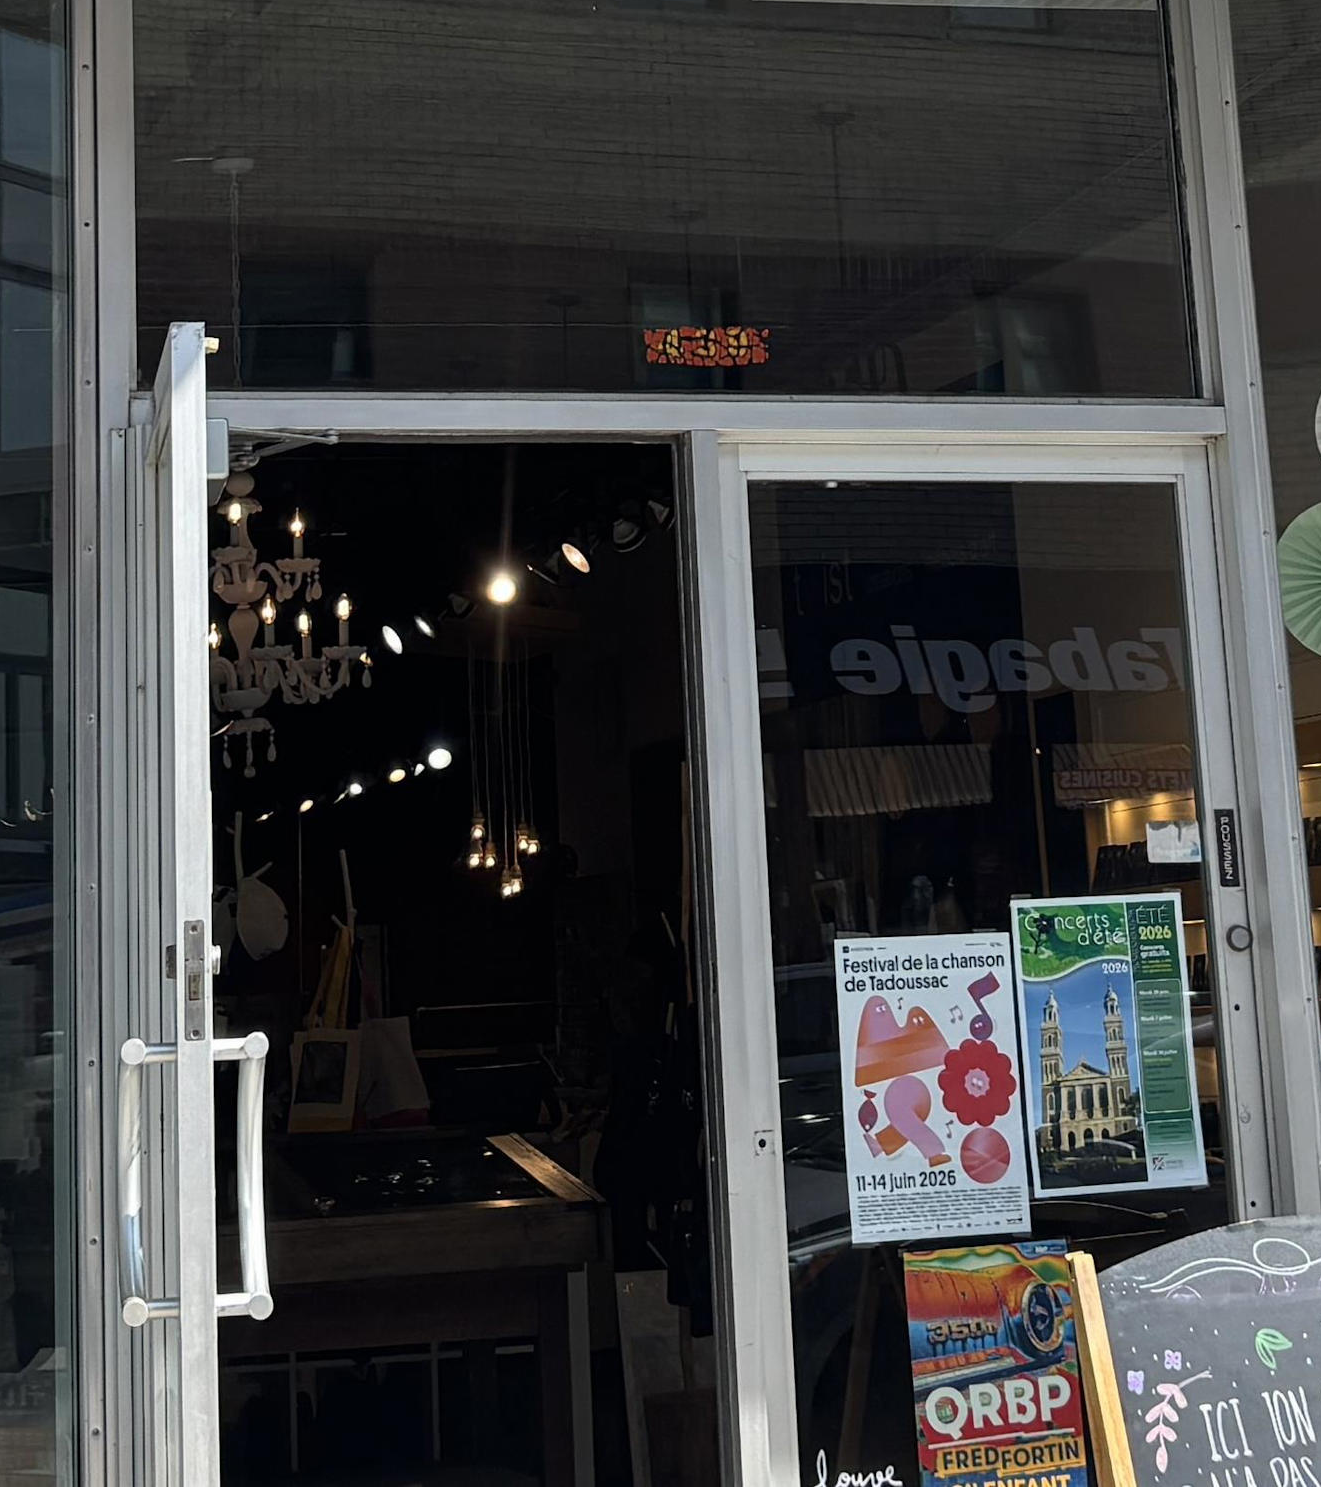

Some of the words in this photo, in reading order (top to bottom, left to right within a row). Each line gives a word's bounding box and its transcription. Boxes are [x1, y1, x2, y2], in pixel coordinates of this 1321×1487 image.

[1219, 816, 1234, 880] POUSSEZ
[1136, 905, 1170, 924] ÉTÉ
[1138, 925, 1172, 941] 2026
[843, 954, 899, 974] Festival
[901, 954, 923, 970] de
[925, 953, 939, 969] la
[941, 953, 1005, 969] chanson
[1101, 962, 1129, 974] 2026
[844, 976, 867, 993] de
[869, 974, 949, 992] Tadoussac
[855, 1173, 886, 1192] 11-14
[889, 1172, 917, 1193] juin
[919, 1169, 957, 1188] 2026
[925, 1374, 1072, 1441] QRBP
[1199, 1398, 1254, 1462] ICI
[942, 1446, 1000, 1471] FRED
[1000, 1440, 1080, 1470] FORTIN
